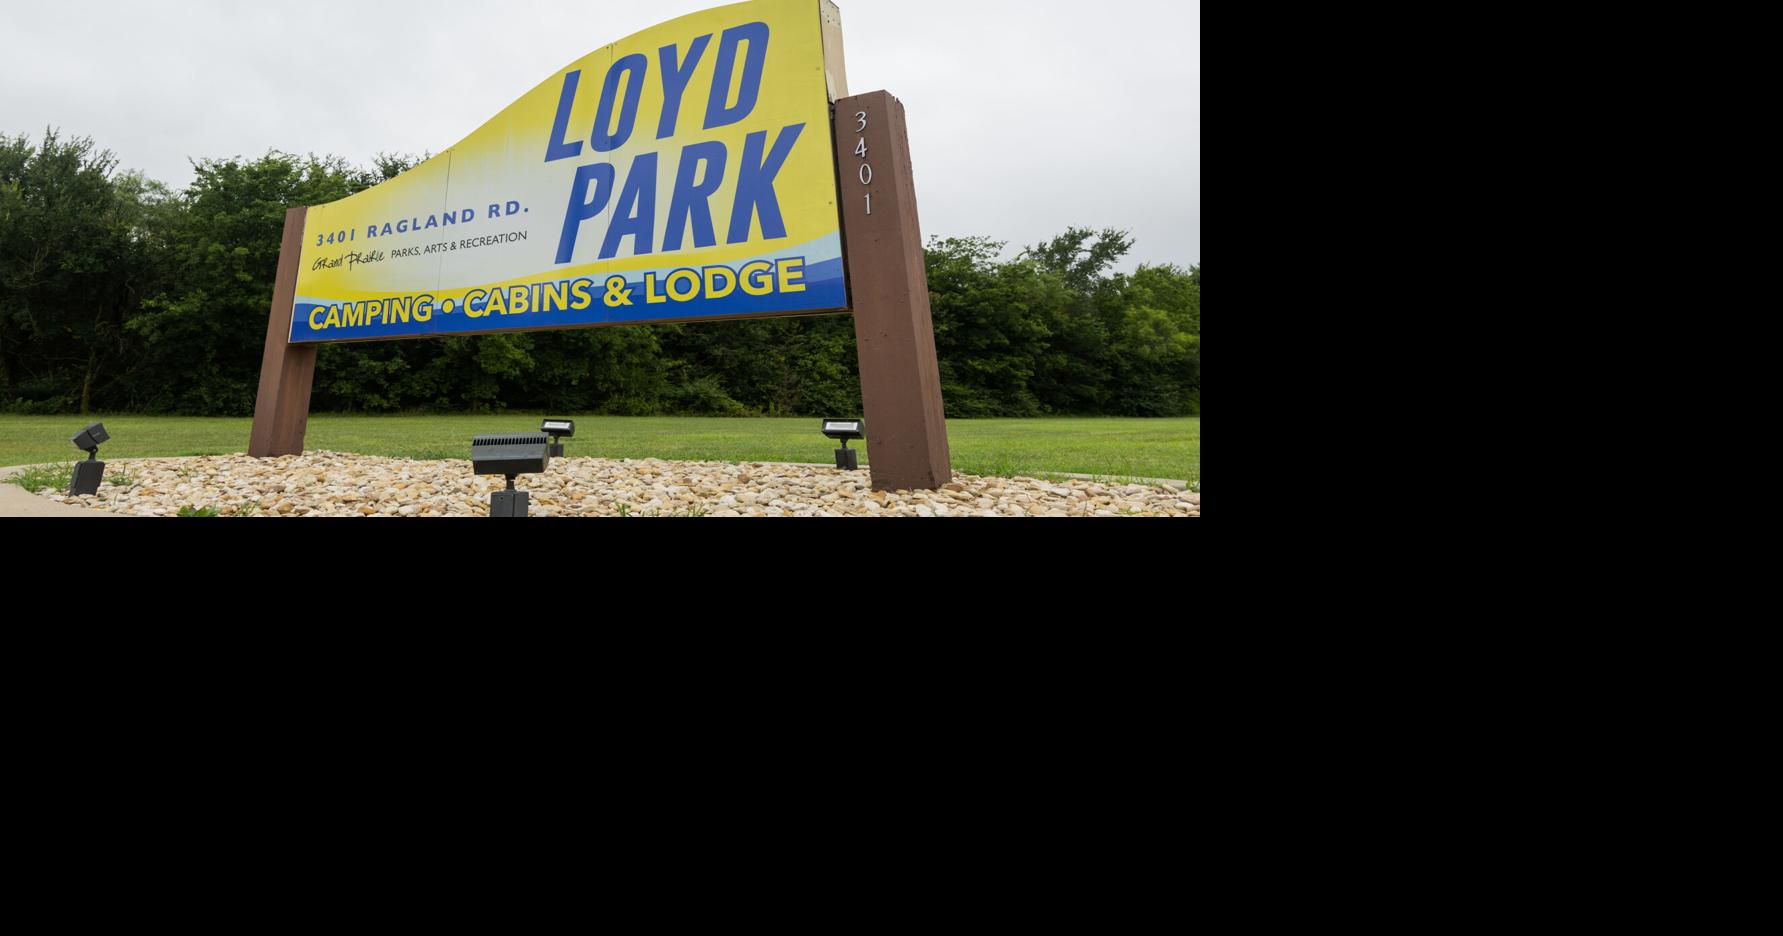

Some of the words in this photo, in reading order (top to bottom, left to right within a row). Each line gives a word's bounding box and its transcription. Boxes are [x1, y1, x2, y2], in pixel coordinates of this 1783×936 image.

[544, 21, 770, 163] LOYD
[554, 122, 806, 264] PARK
[854, 111, 872, 215] 3401
[312, 253, 343, 271] Grand
[343, 250, 385, 271] Prairie
[391, 246, 421, 259] PARKS,
[423, 242, 448, 255] ARTS
[450, 241, 457, 251] &
[459, 230, 528, 249] RECREATION
[316, 228, 355, 247] 3401
[367, 208, 475, 239] RAGLAND
[488, 200, 530, 219] RD.
[308, 294, 434, 331] CAMPING
[462, 275, 594, 318] CABINS
[603, 275, 634, 308] &
[644, 256, 807, 304] LODGE
